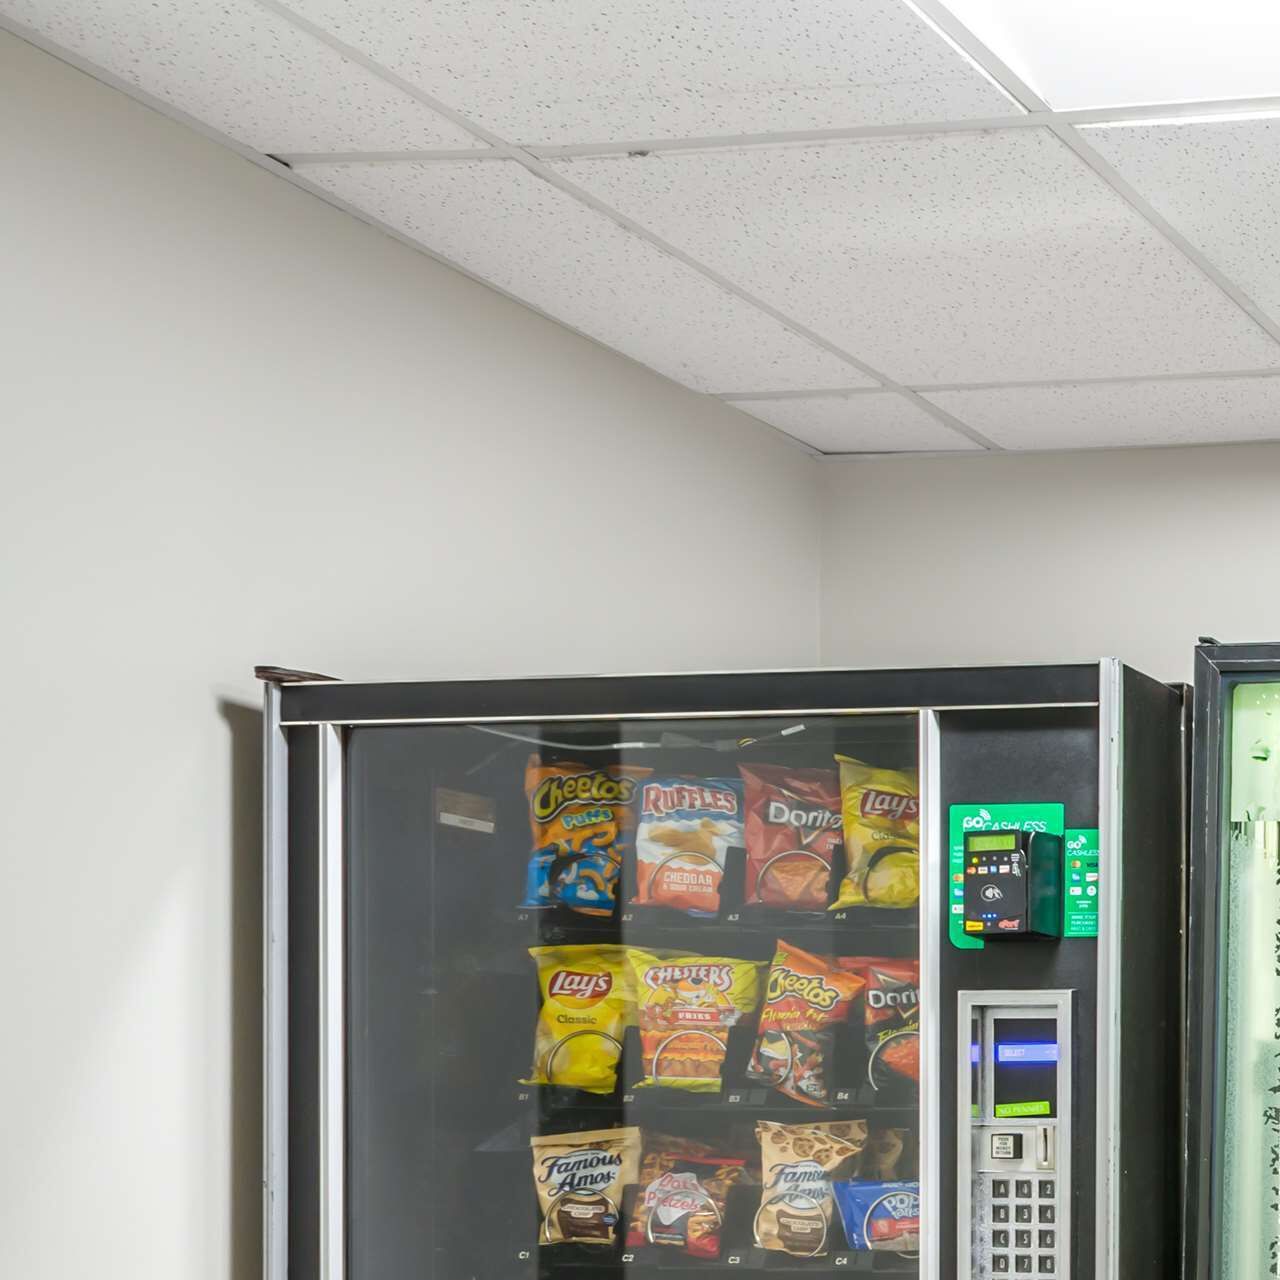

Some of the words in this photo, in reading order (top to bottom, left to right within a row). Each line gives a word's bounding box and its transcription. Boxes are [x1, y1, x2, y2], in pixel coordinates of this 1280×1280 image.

[534, 772, 634, 820] Cheetos
[644, 784, 737, 816] RUFFLES
[563, 808, 612, 828] Puffs
[769, 801, 842, 828] Dorito
[963, 816, 984, 828] GO
[664, 872, 712, 885] CHEDDAR
[834, 912, 846, 920] A4
[645, 965, 733, 992] CHESTER'S
[768, 966, 839, 1009] Cheetos
[868, 988, 919, 1008] Dori
[556, 1014, 598, 1024] Classic
[678, 1012, 711, 1020] FRIES
[538, 1152, 622, 1184] Famous
[548, 1168, 615, 1197] Amos
[644, 1192, 701, 1211] Pretzels
[518, 1251, 529, 1259] C1
[622, 1254, 634, 1262] C2
[728, 1256, 740, 1264] C3
